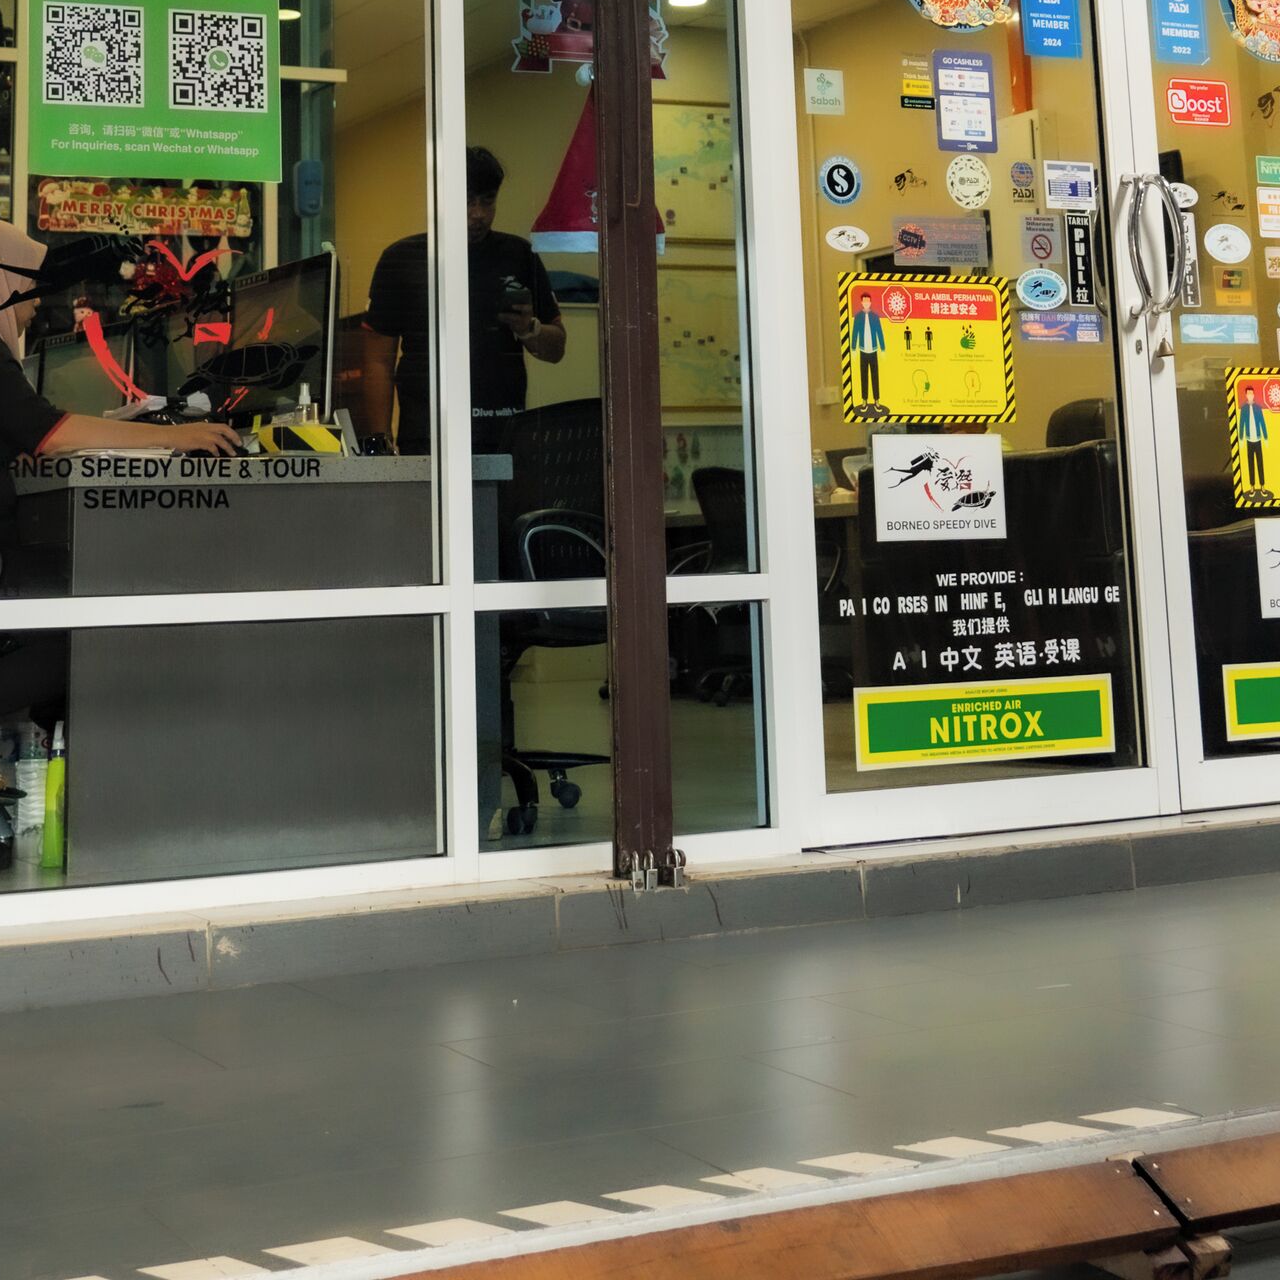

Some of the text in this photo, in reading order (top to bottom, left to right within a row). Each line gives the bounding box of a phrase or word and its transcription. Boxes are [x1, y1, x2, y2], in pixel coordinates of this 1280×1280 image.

[1169, 2, 1189, 14] PADI
[1032, 18, 1070, 30] MEMBER
[1162, 27, 1200, 39] MEMBER
[1043, 37, 1061, 47] 2024
[953, 57, 983, 66] CASHLESS
[810, 96, 841, 107] Sabah
[51, 138, 259, 158] For scan Wechat or Whatsapp
[60, 199, 238, 222] MERRY CHRISTMAS
[1068, 216, 1089, 226] TARIK
[914, 292, 994, 303] SILA AMBIL PERHATIAN!
[1076, 287, 1089, 303] 拉
[930, 303, 978, 316] 请注意安全
[81, 457, 320, 479] SPEEDY DIVE & TOUR
[83, 488, 230, 511] SEMPORNA
[886, 519, 997, 531] BORNEO SPEEDY DIVE
[936, 571, 1017, 587] WE PROVIDE
[952, 616, 1011, 637] 我们提供
[951, 699, 1021, 714] ENRICHED AIR
[930, 710, 1044, 744] NITROX
